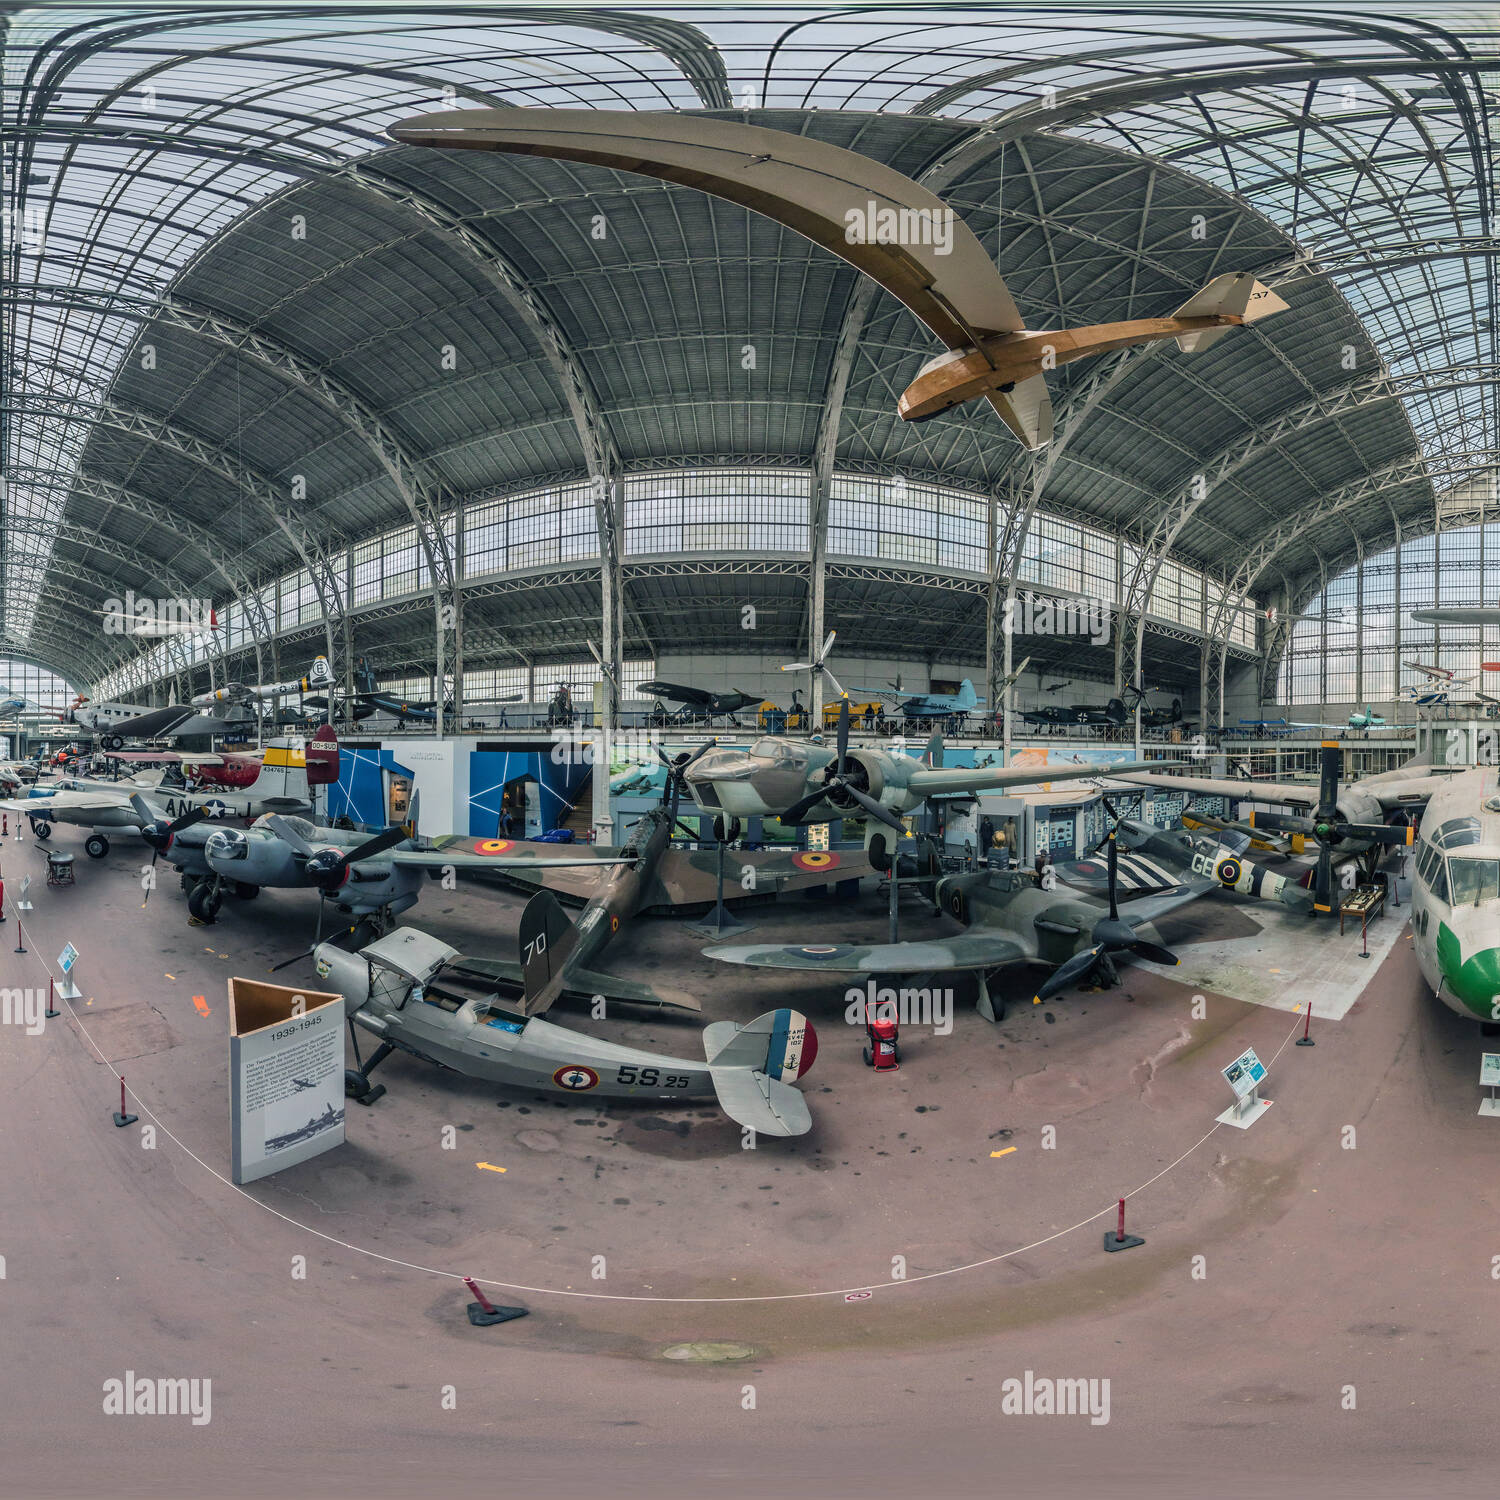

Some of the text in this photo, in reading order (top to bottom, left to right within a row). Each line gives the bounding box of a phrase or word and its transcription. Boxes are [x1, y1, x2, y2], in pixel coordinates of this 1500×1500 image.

[1191, 853, 1215, 878] GE
[524, 932, 547, 966] 70
[271, 1015, 322, 1042] 1939-1945
